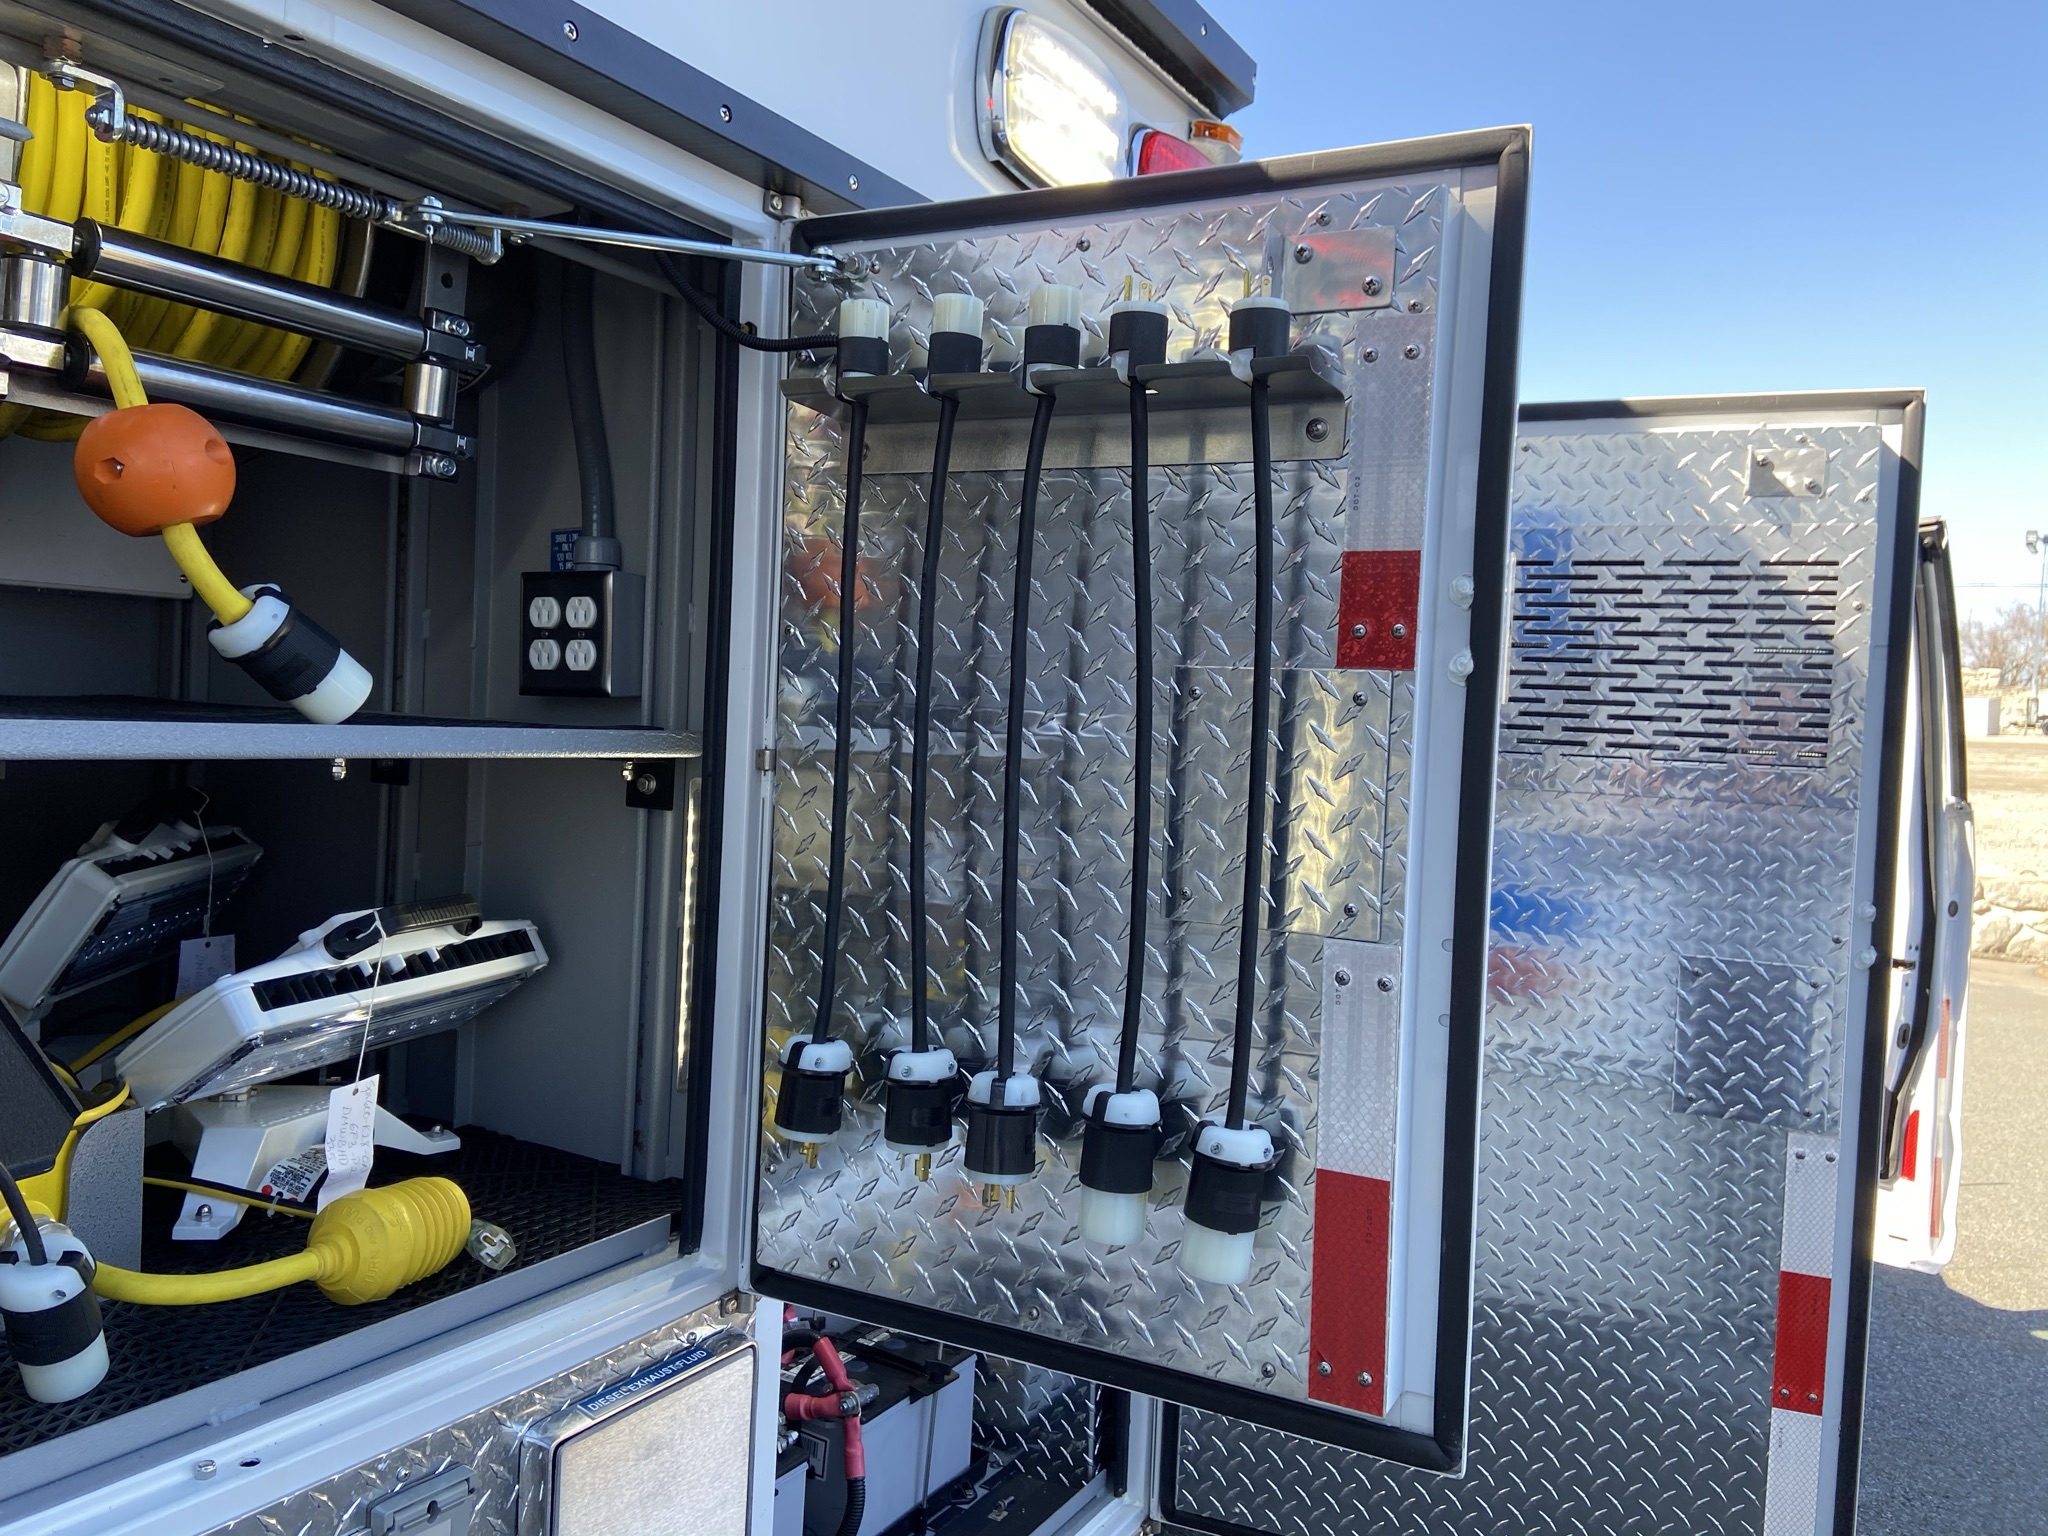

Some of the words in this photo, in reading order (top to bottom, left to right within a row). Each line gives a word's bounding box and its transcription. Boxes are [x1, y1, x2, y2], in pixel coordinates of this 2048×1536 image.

[1352, 476, 1361, 511] DOT-C2
[364, 1250, 380, 1284] TURN
[587, 1389, 630, 1411] DIESEL
[627, 1365, 678, 1392] EXHAUST
[675, 1350, 707, 1369] FLUID
